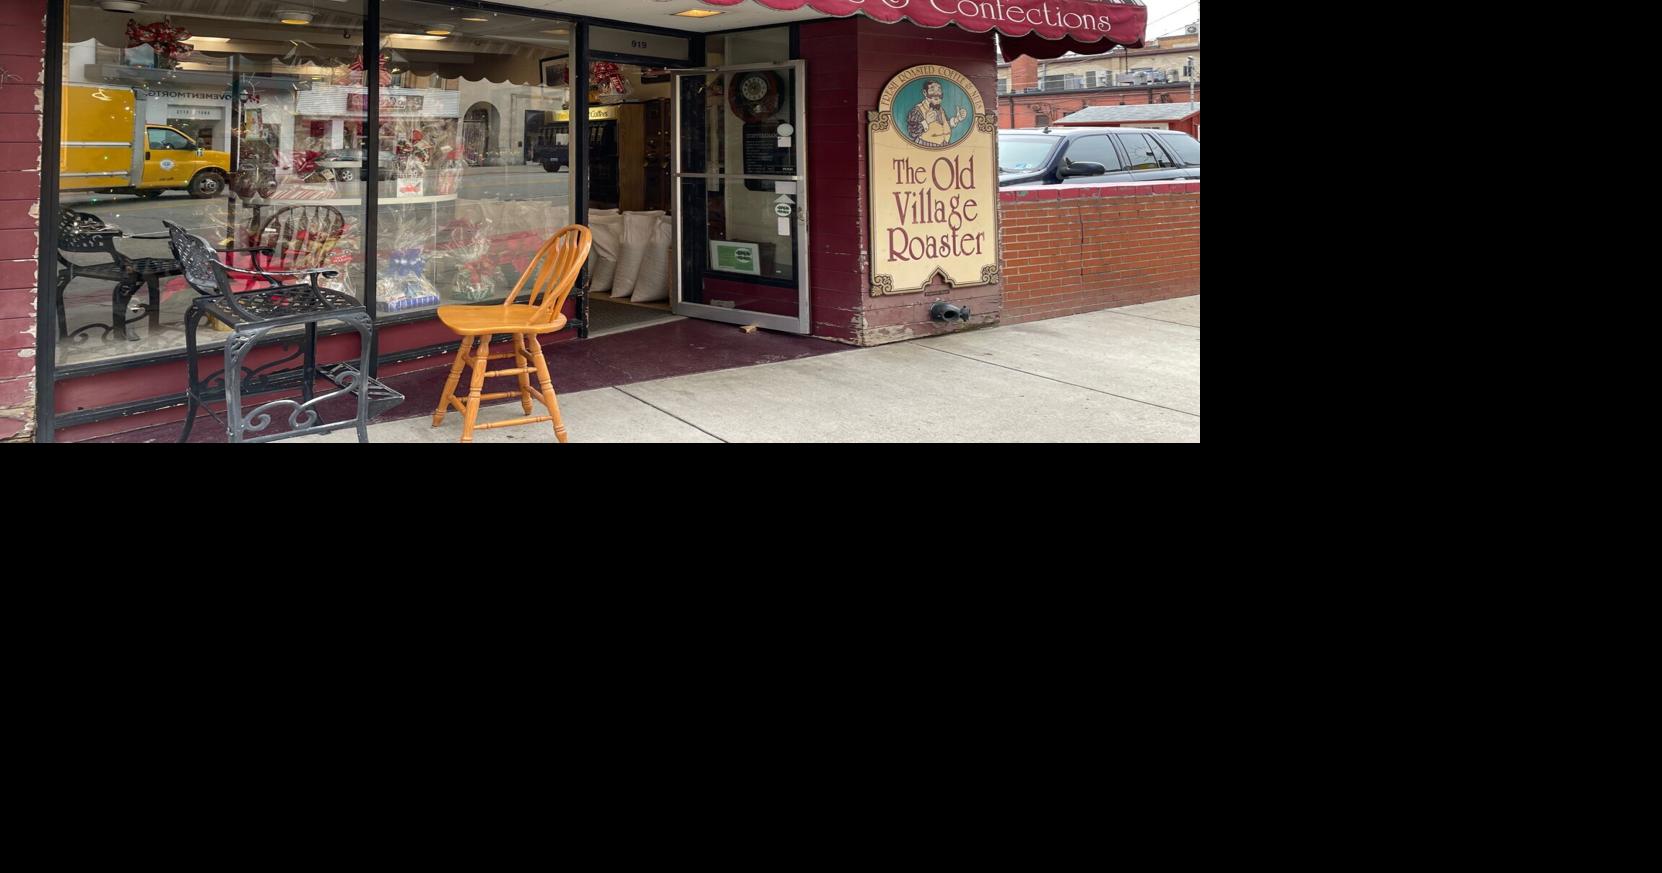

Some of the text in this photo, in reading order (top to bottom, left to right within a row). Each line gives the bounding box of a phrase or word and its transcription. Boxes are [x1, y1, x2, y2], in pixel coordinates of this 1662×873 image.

[898, 66, 935, 82] ROASTED
[892, 155, 975, 191] The Old
[892, 188, 978, 230] Village
[887, 226, 985, 262] Roaster
